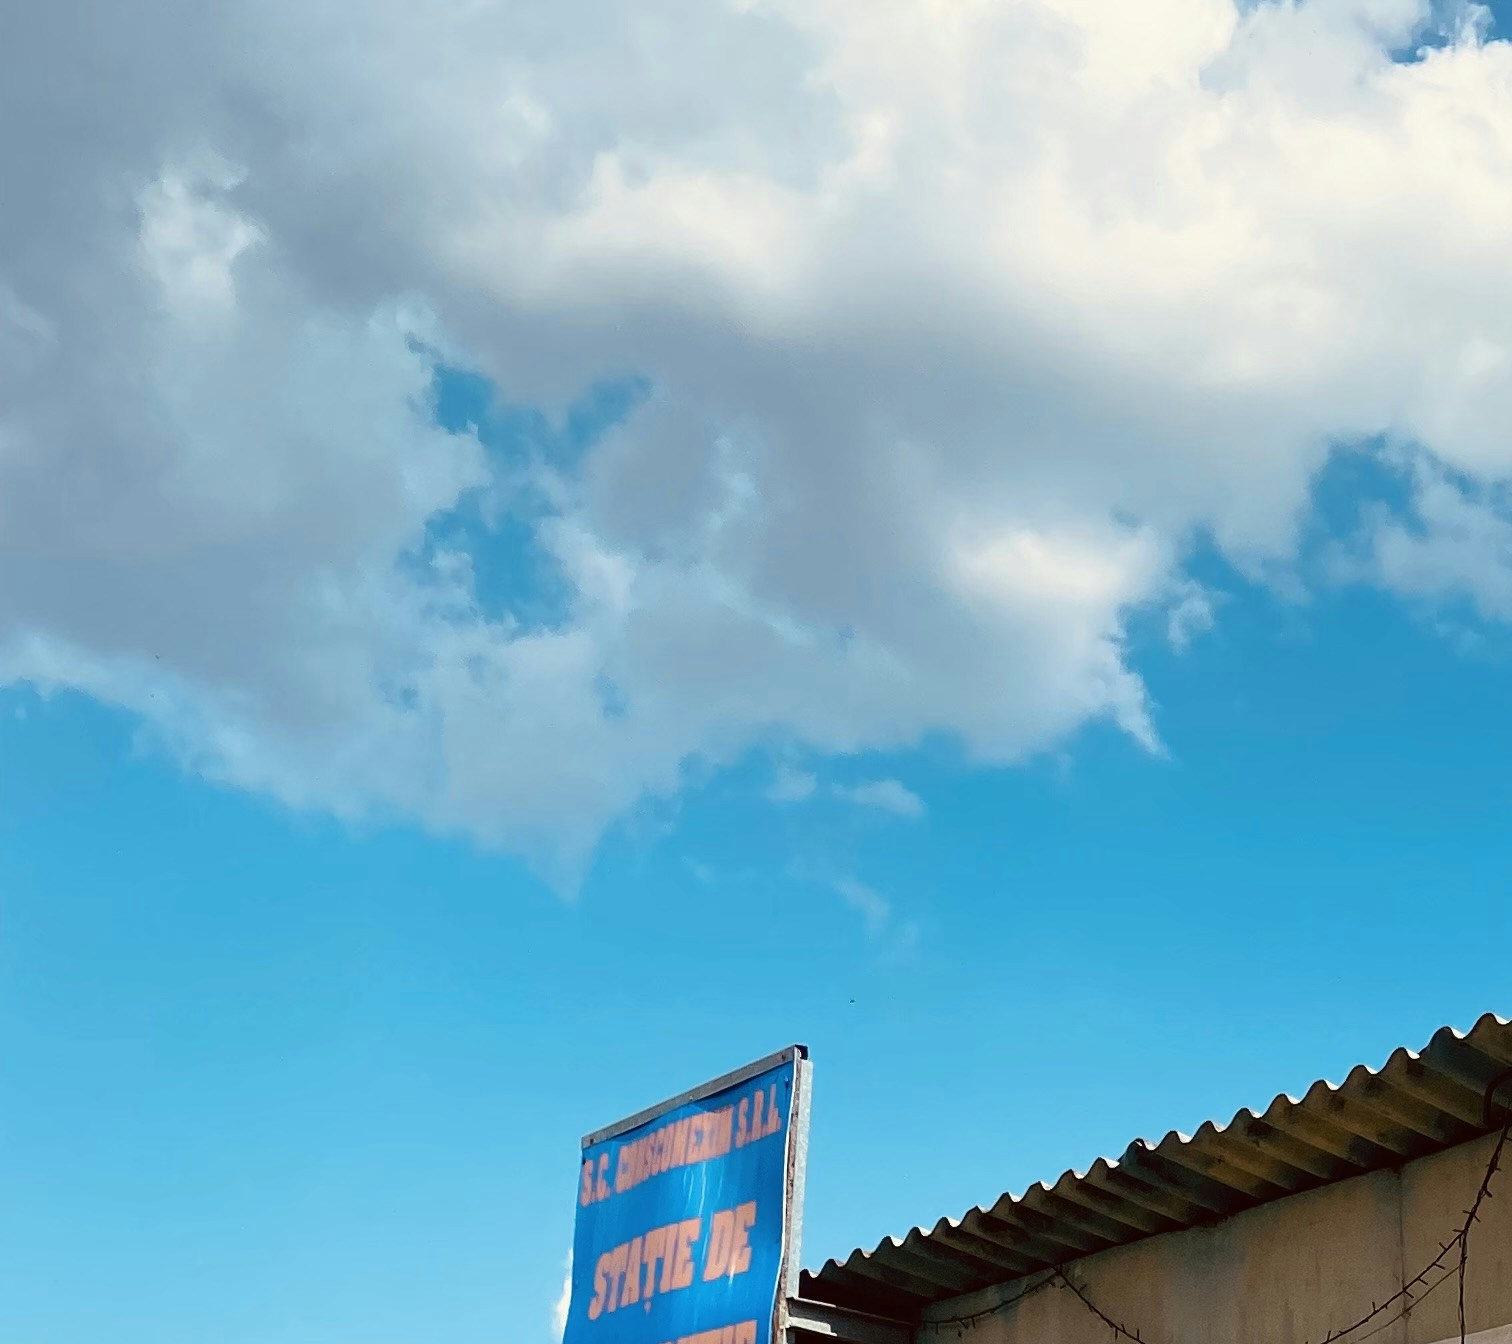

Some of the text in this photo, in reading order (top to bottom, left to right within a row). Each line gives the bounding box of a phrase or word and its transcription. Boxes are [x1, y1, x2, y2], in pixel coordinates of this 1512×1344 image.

[581, 1153, 611, 1207] S.C.
[588, 1200, 757, 1320] STAȚIE DE
